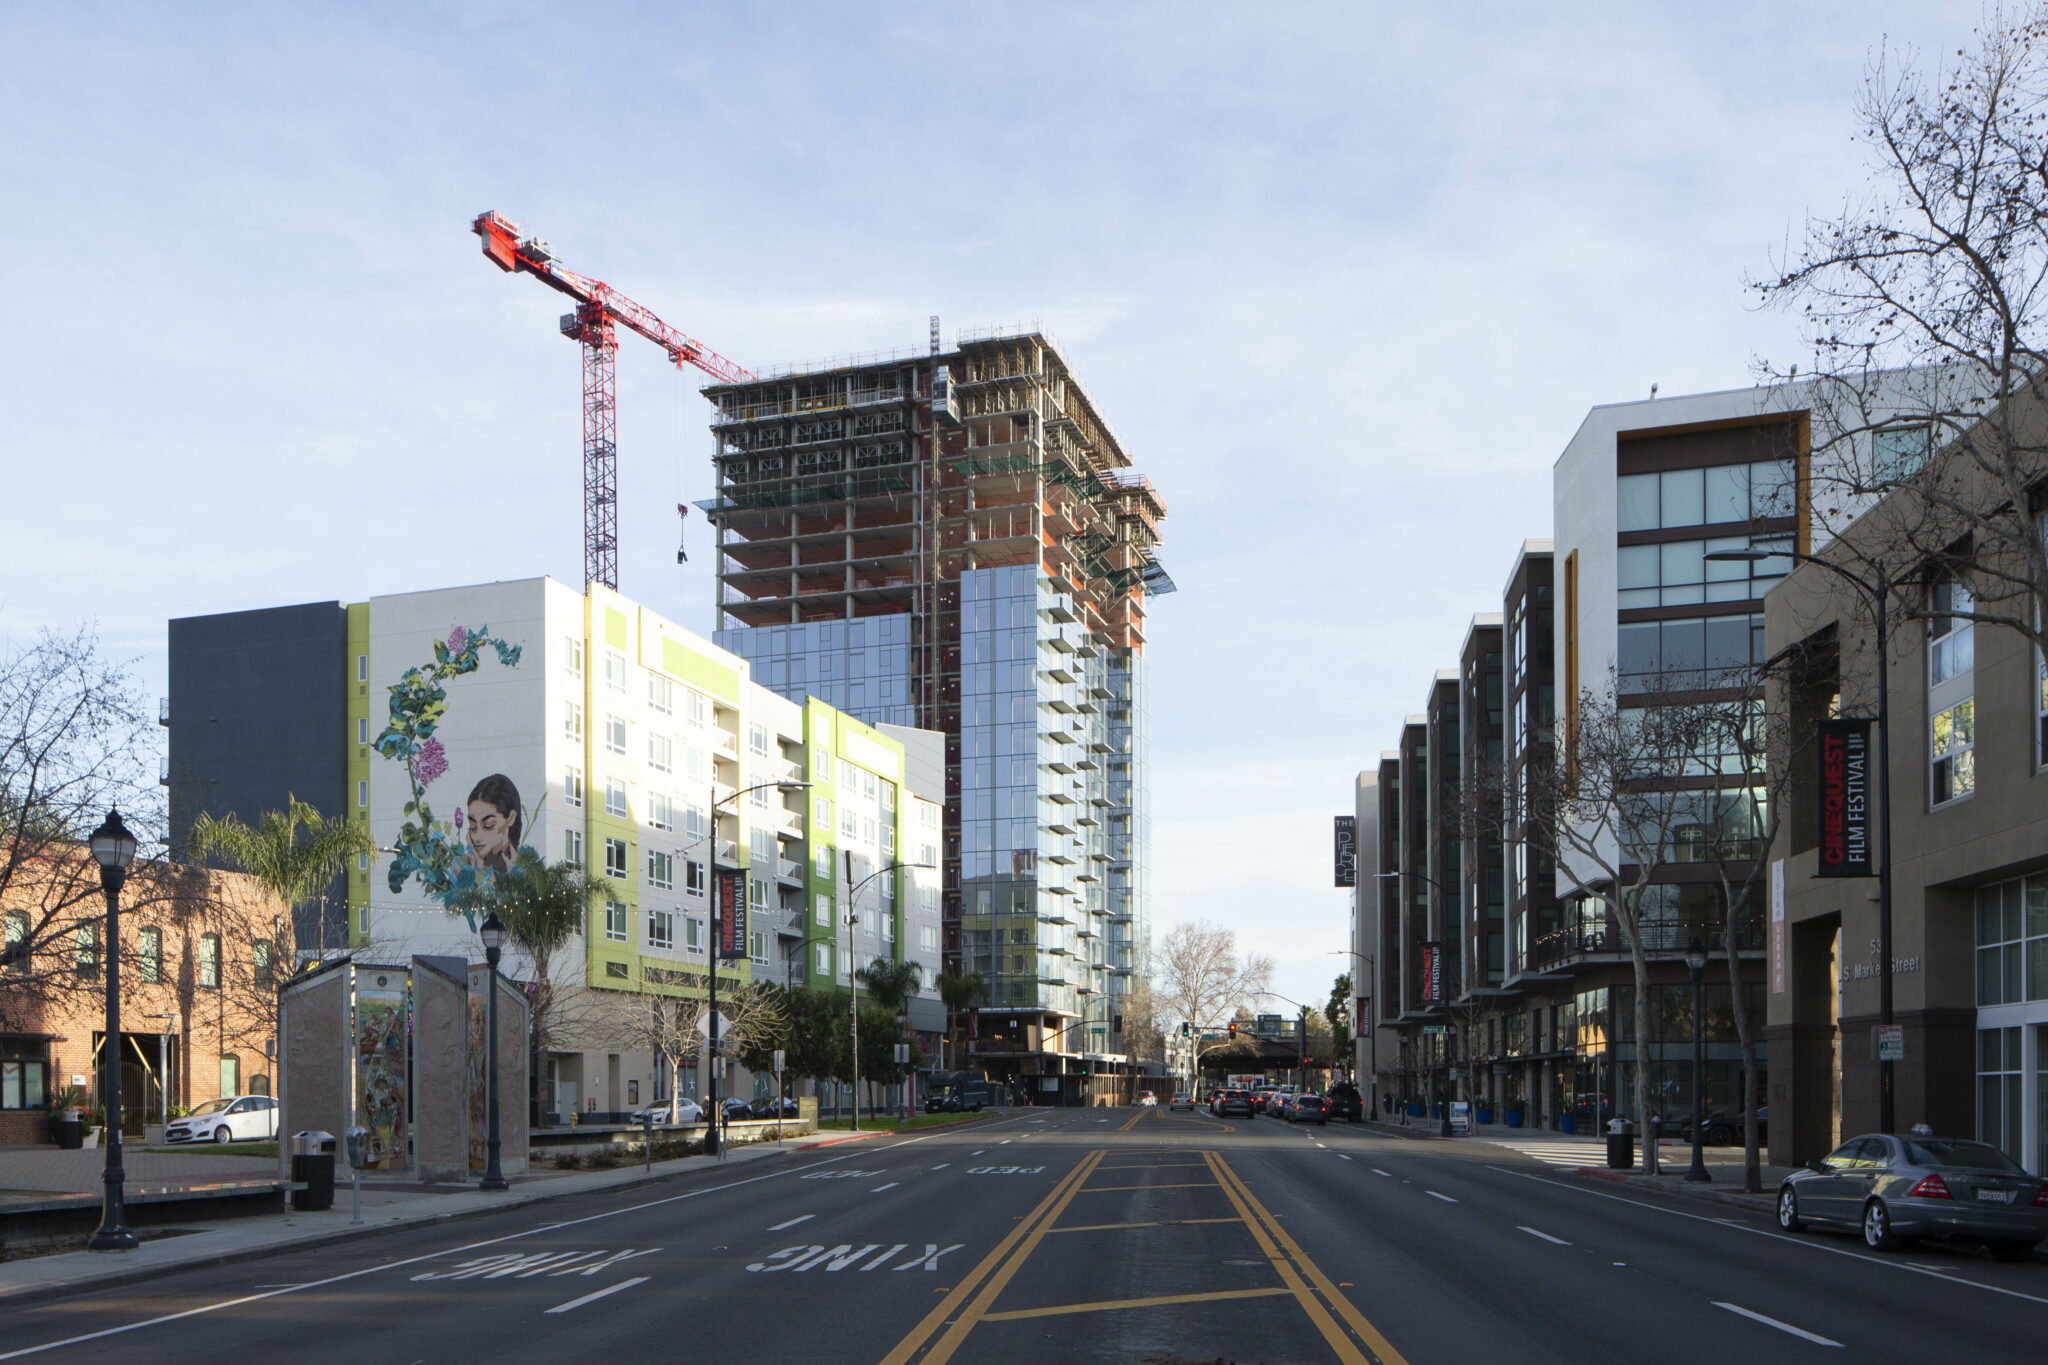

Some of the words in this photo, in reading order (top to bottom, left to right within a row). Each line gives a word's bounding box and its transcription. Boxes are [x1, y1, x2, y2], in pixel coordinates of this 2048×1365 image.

[1824, 734, 1844, 865] CINEQUEST
[1847, 752, 1864, 822] FESTIVAL
[1848, 827, 1865, 863] FILM
[723, 876, 734, 952] CINEQUEST
[735, 887, 744, 927] FESTIVAL
[735, 931, 744, 951] FILM
[1843, 966, 1852, 981] S.
[1854, 960, 1881, 979] Marke
[1432, 984, 1440, 1000] FILM
[409, 1247, 663, 1281] XING
[745, 1243, 965, 1272] XING
